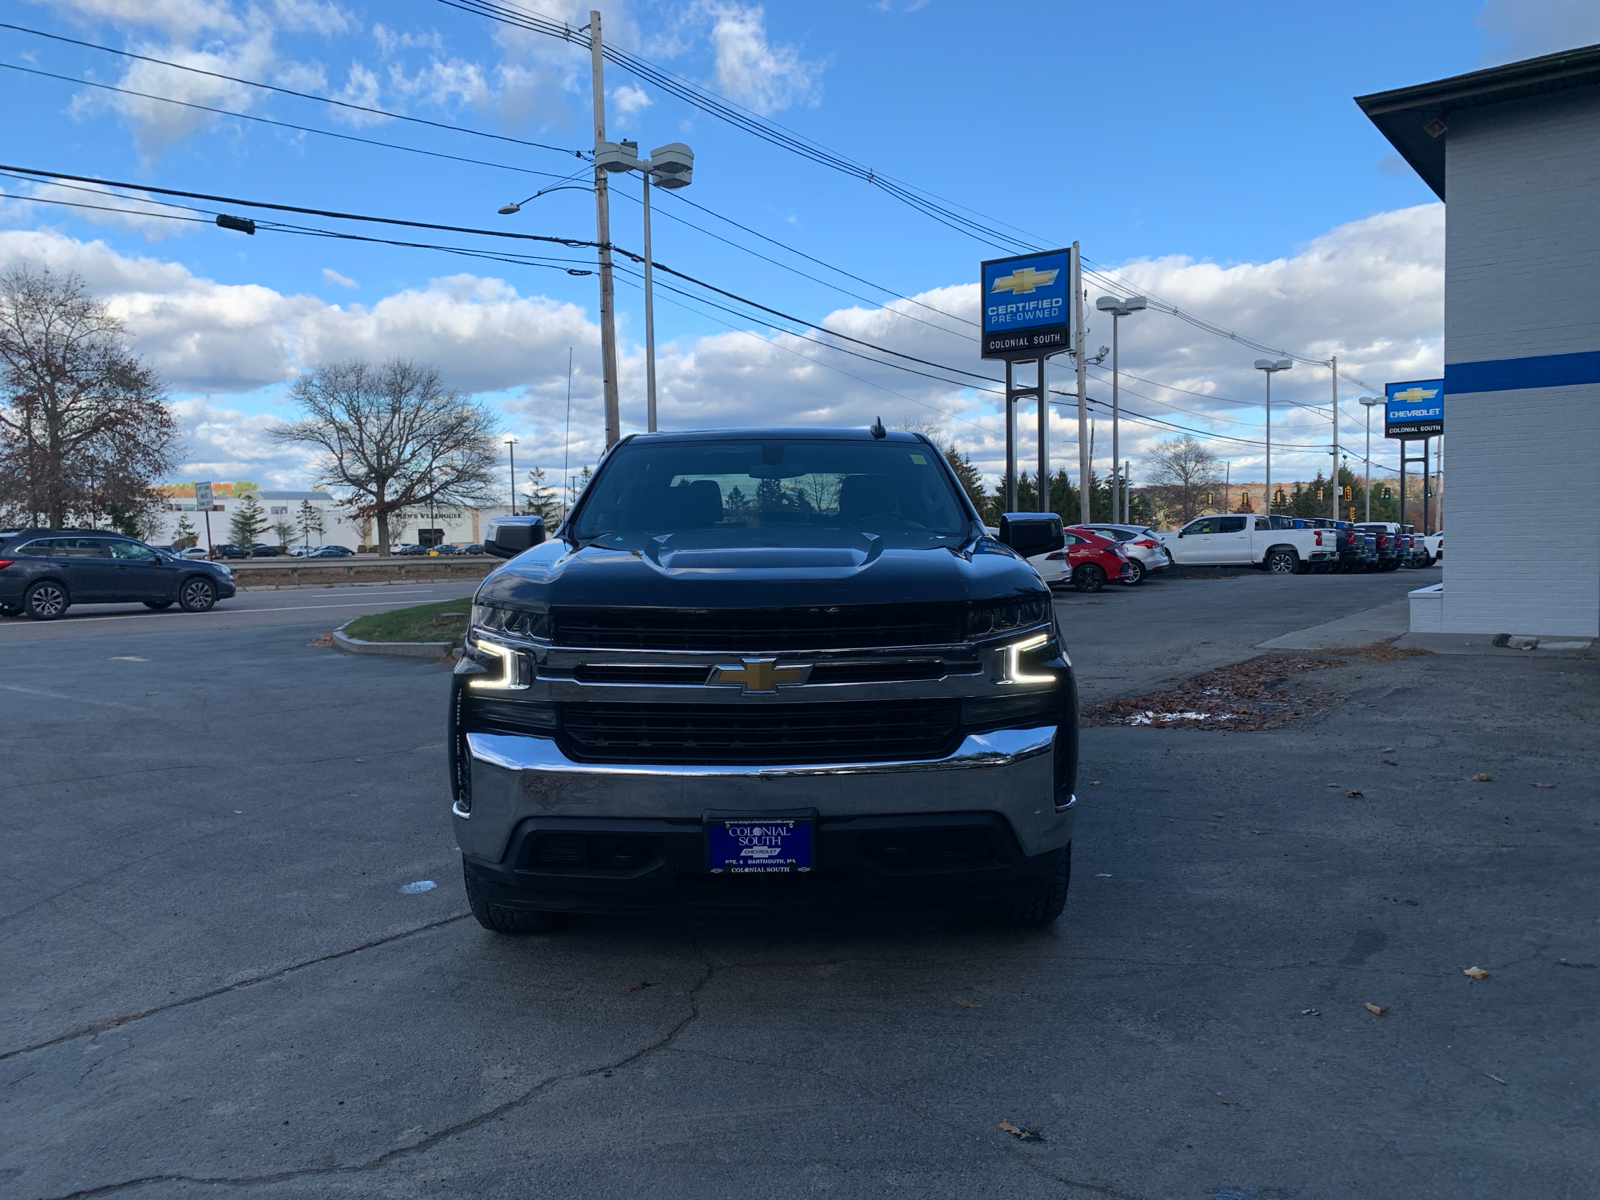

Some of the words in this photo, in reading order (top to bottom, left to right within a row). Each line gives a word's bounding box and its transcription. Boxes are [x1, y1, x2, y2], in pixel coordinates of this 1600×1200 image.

[988, 298, 1062, 315] CERTIFIED
[991, 308, 1058, 324] PRE-OWNED
[989, 338, 1029, 349] COLONIAL
[1033, 334, 1060, 344] SOUTH
[1390, 408, 1440, 418] CHEVROLET
[729, 827, 791, 836] COLONIAL
[738, 837, 781, 846] SOUTH
